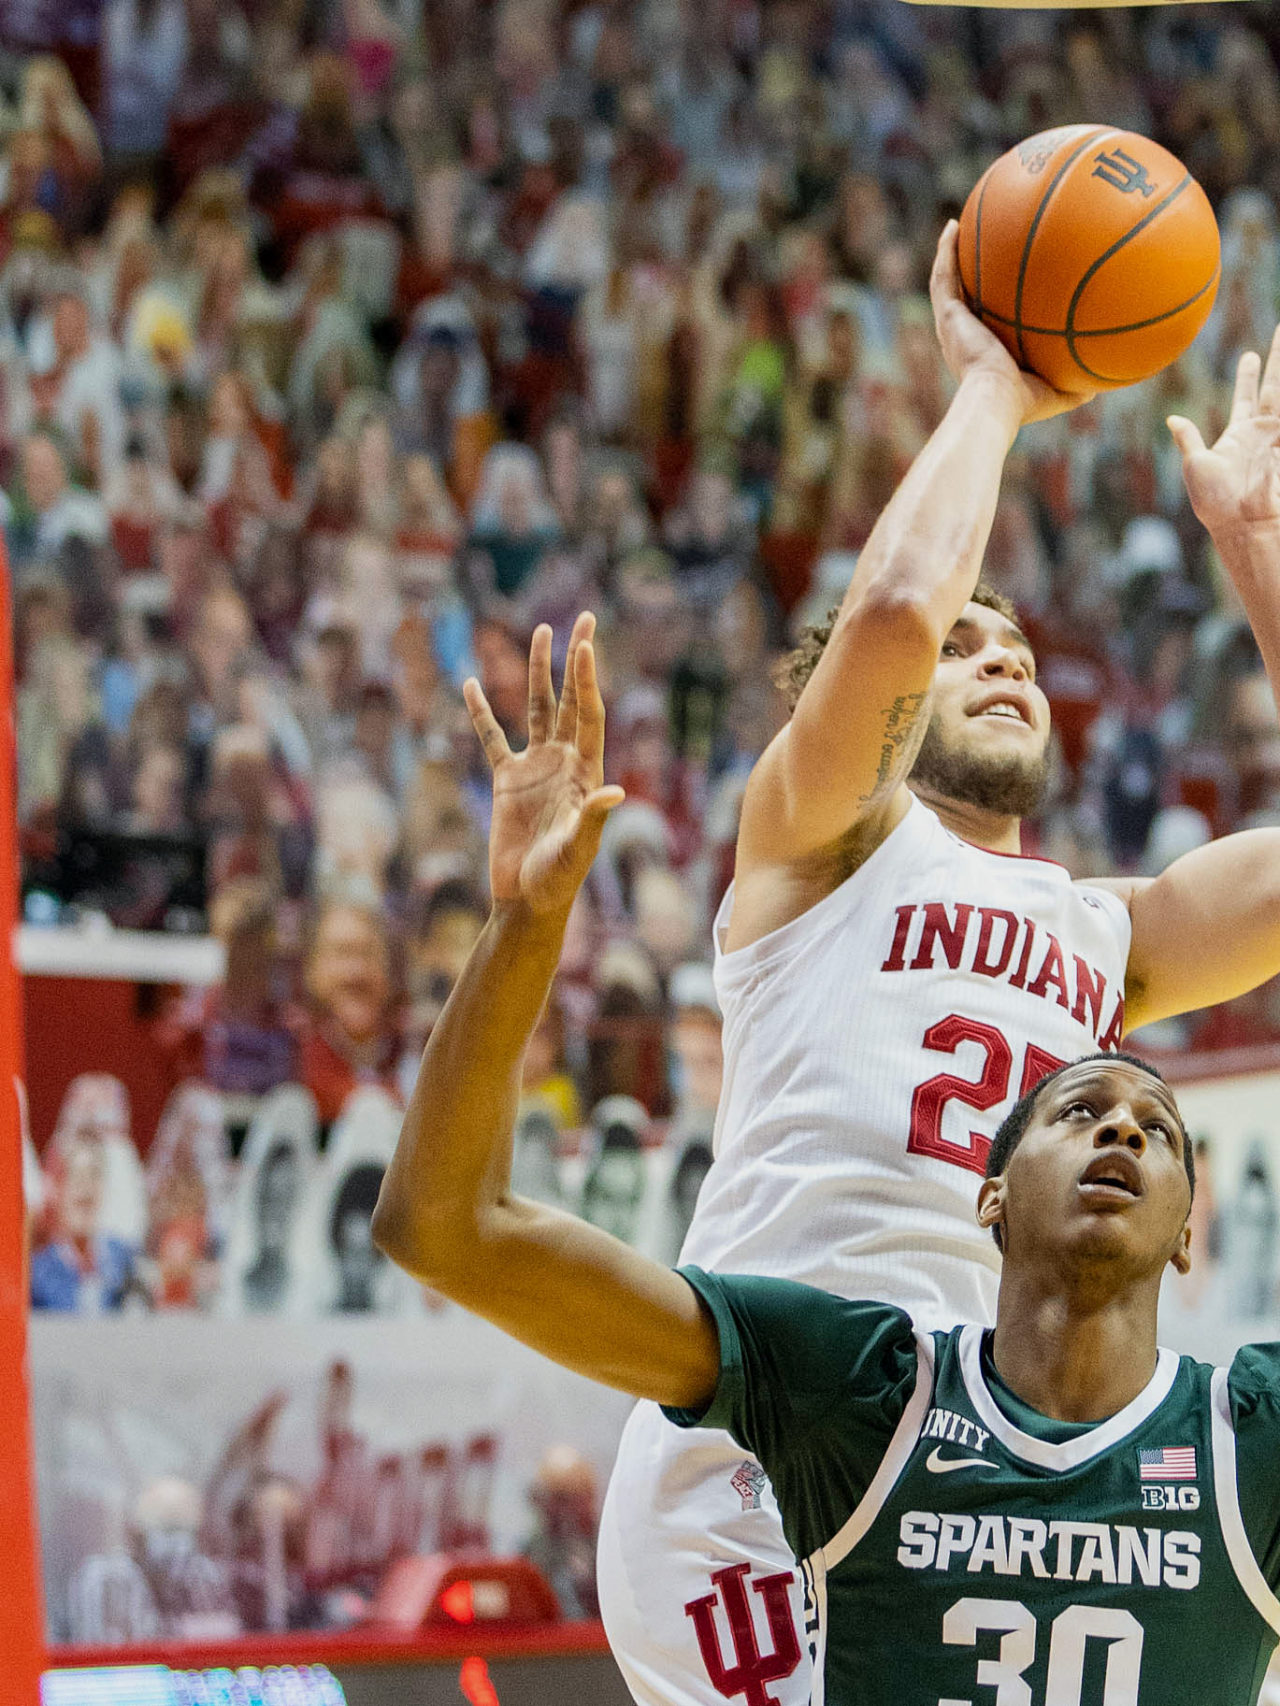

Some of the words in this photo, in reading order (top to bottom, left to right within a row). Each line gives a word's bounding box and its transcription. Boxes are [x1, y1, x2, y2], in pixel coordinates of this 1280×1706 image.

[881, 902, 1126, 1052] INDIANA
[897, 1510, 1202, 1590] SPARTANS
[942, 1597, 1144, 1706] 30
